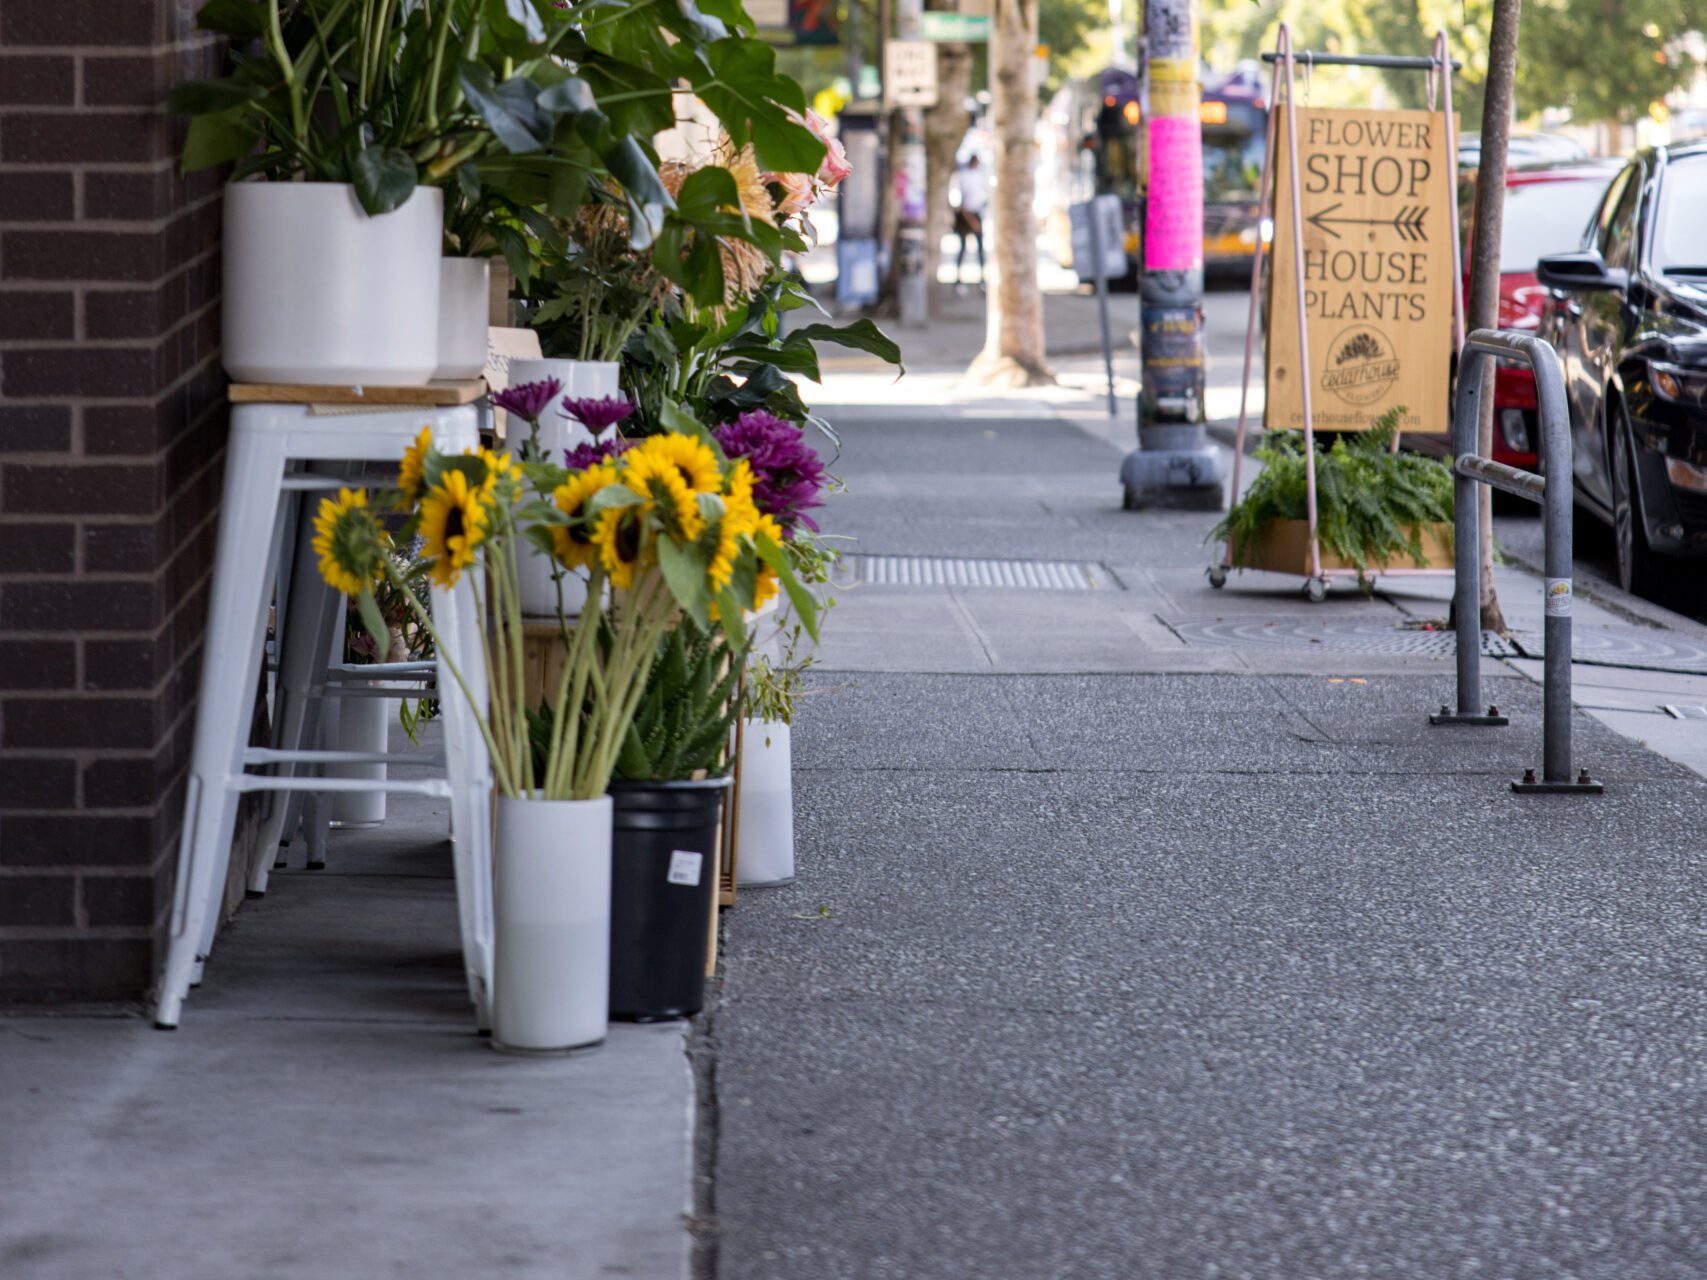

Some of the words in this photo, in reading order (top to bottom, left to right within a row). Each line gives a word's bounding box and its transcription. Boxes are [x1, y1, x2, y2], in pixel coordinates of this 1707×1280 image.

[1308, 118, 1431, 149] FLOWER
[1306, 153, 1431, 197] SHOP
[1304, 249, 1427, 284] HOUSE
[1305, 290, 1426, 321] PLANTS
[1321, 362, 1400, 388] cedarhouse
